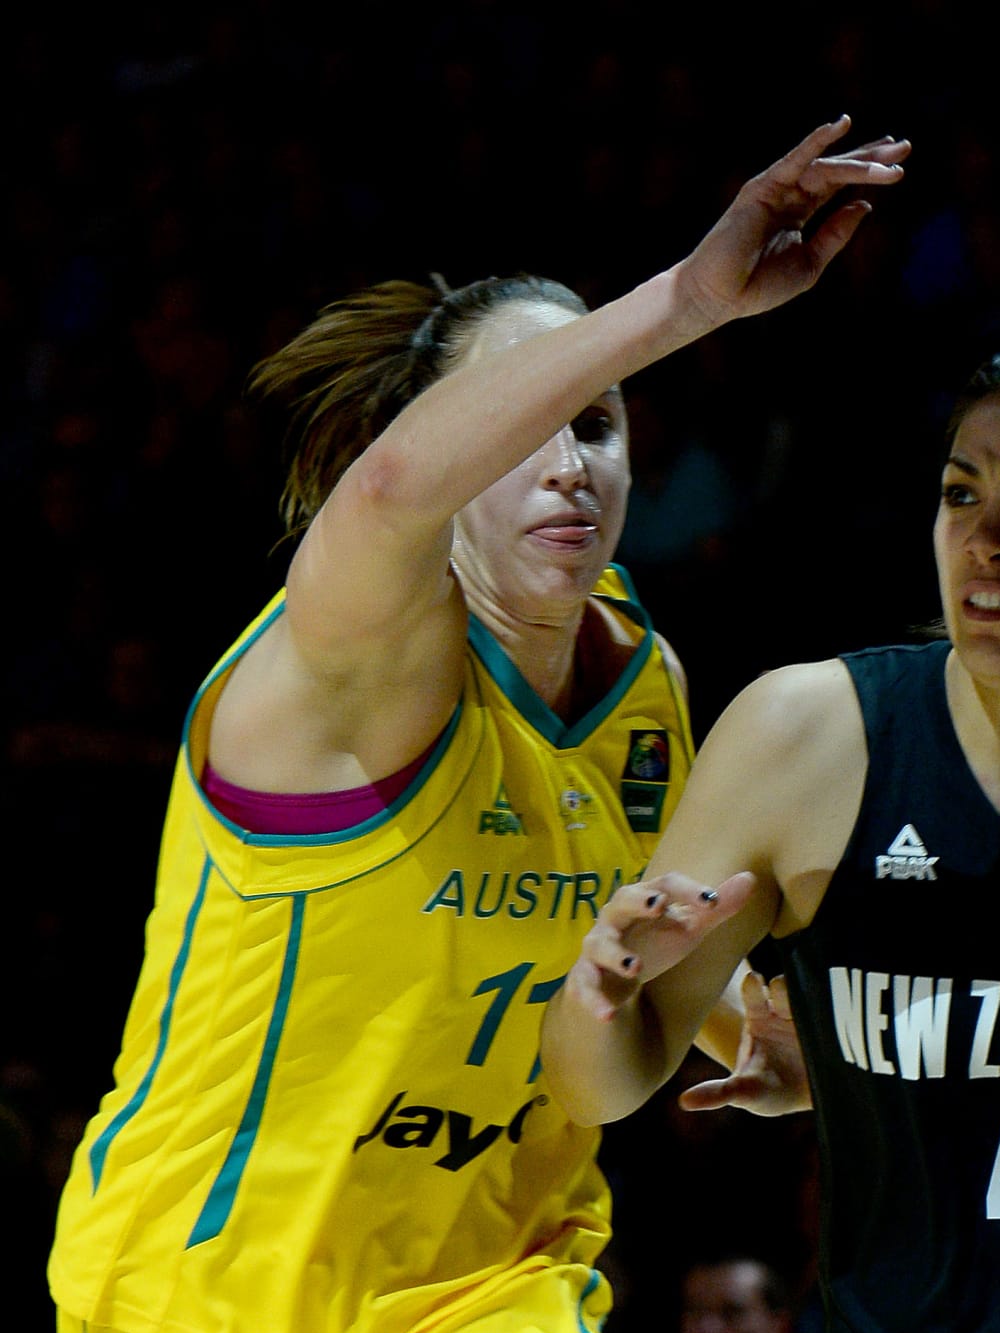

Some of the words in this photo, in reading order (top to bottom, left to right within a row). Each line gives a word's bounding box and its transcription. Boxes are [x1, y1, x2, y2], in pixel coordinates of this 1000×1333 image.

[422, 868, 645, 919] AUSTR
[875, 855, 940, 881] PEAK
[829, 966, 954, 1081] NEW
